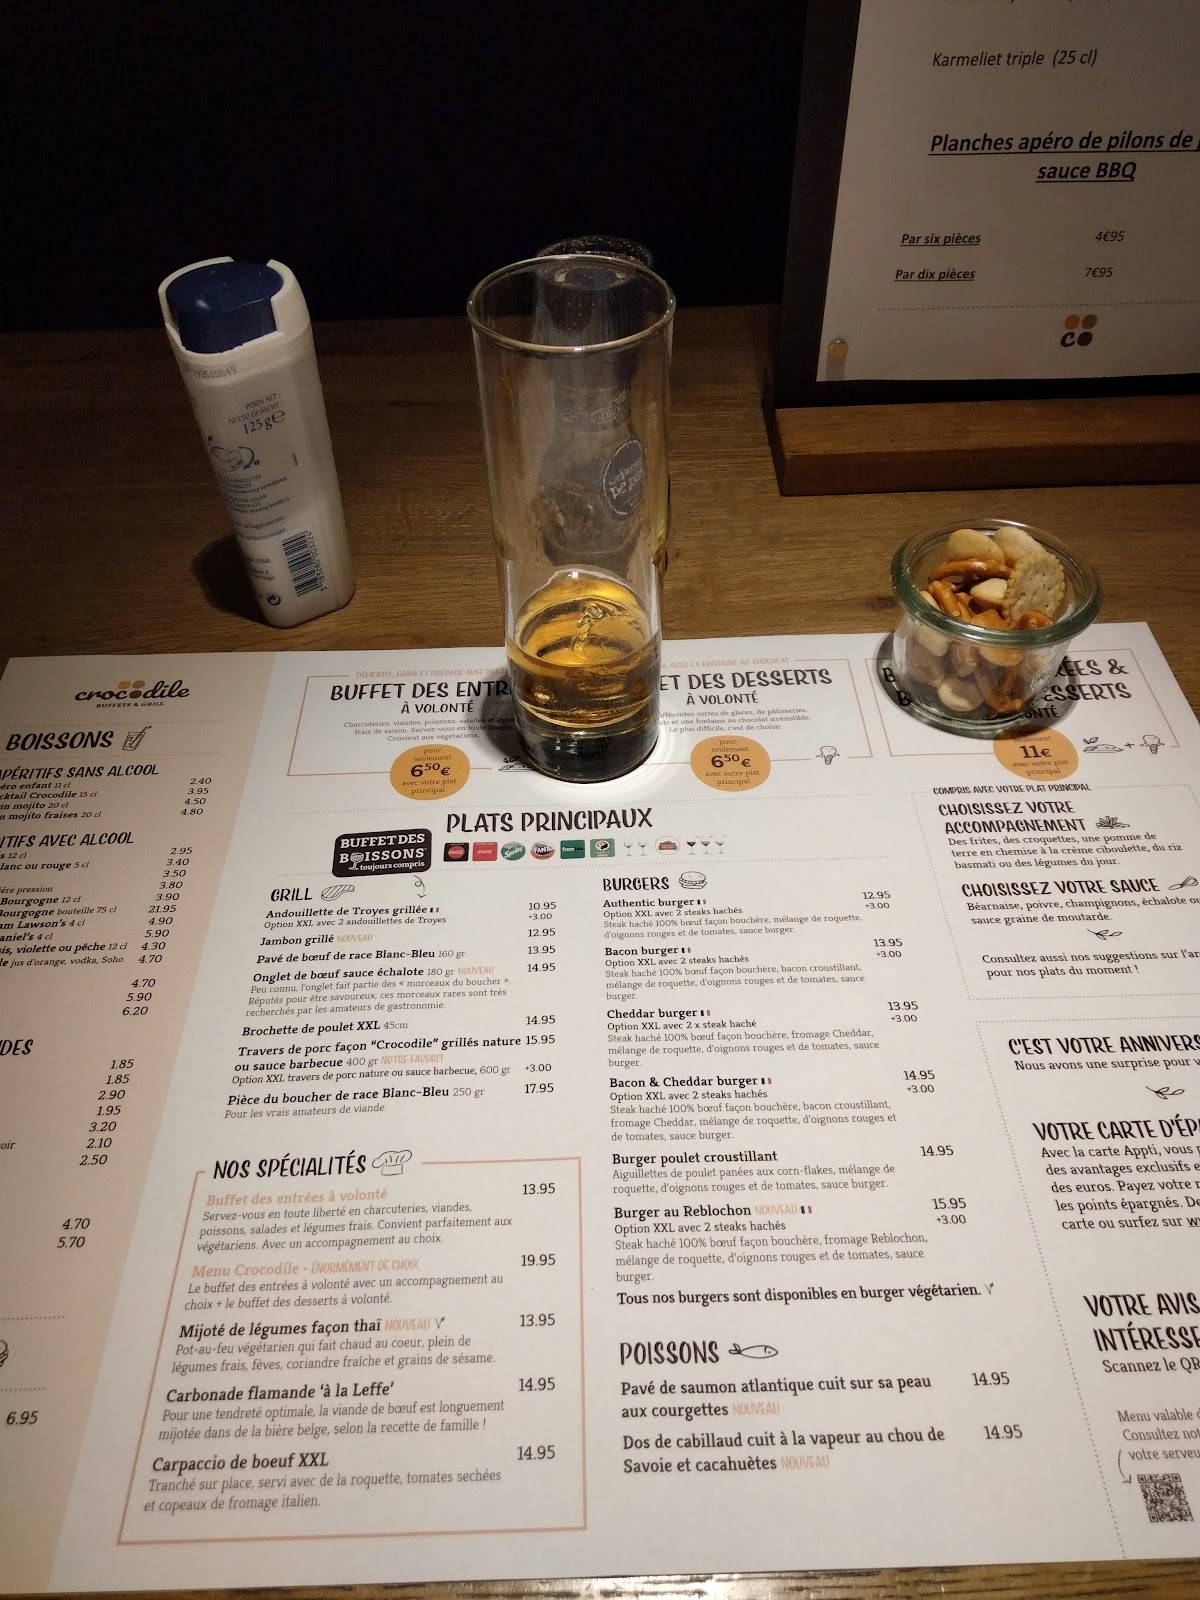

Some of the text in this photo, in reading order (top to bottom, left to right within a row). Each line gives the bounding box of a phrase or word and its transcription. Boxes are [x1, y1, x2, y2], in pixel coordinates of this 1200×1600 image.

[932, 49, 1098, 68] Karmeliet triple (25 cl)
[930, 130, 1193, 153] Planches apéro de pilons de
[1037, 162, 1137, 181] sauce BBQ
[901, 232, 982, 247] Par six pièces
[1095, 230, 1125, 242] 4€95
[895, 268, 976, 282] Par dix pièces
[1084, 267, 1113, 278] 7€95
[687, 668, 833, 690] DES DESSERTS
[330, 682, 449, 701] BUFFET DES
[456, 680, 512, 697] ENTR
[401, 699, 474, 714] À VOLONTÉ
[5, 730, 114, 751] BOISSONS
[1019, 745, 1052, 759] 11€
[0, 762, 159, 781] PÉRITIFS SANS ALCOOL
[190, 777, 212, 785] 2.40
[187, 787, 209, 795] 3.95
[933, 783, 1092, 795] COMPRIS AVEC VOTRE PLAT PRINCIPAL
[12, 801, 46, 812] mojito
[60, 801, 69, 809] cl
[183, 797, 207, 806] 4.50
[180, 808, 204, 816] 4.80
[938, 801, 1073, 816] CHOISISSEZ VOTRE
[446, 807, 653, 833] PLATS PRINCIPAUX
[945, 818, 1086, 835] ACCOMPAGNEMENT
[38, 831, 134, 847] AVEC ALCOOL
[340, 833, 425, 849] BUFFET DES
[947, 838, 968, 846] Des
[969, 837, 1001, 846] frites,
[1002, 835, 1021, 844] des
[1022, 835, 1080, 846] croquettes,
[1103, 834, 1142, 845] pomme
[1144, 832, 1157, 840] de
[359, 859, 425, 872] toujours compris
[603, 876, 670, 891] BURGERS
[961, 878, 1161, 898] CHOISISSEZ VOTRE SAUCE
[270, 887, 313, 902] GRILL
[148, 904, 177, 913] 21.95
[265, 905, 428, 919] Andouillette de Troyes grillée
[528, 901, 557, 911] 10.95
[144, 929, 170, 938] 5.90
[260, 933, 374, 947] Jambon grillé NOUVEAU
[528, 928, 556, 937] 12.95
[16, 944, 57, 954] violette
[73, 942, 106, 955] pêche
[108, 943, 118, 951] 12
[119, 942, 128, 950] cl
[140, 941, 166, 951] 4.30
[122, 1006, 149, 1016] 6.20
[888, 1001, 919, 1011] 13.95
[526, 1014, 556, 1025] 14.95
[606, 1008, 698, 1020] Cheddar burger
[241, 1020, 408, 1037] Brochette de poulet XXL 45cm
[1008, 1036, 1115, 1055] C'EST VOTRE
[97, 1089, 126, 1101] 2.90
[609, 1092, 643, 1103] Option
[645, 1091, 666, 1101] XXL
[692, 1090, 699, 1100] 2
[701, 1089, 732, 1099] steaks
[734, 1089, 768, 1099] hachés
[1032, 1119, 1158, 1141] VOTRE CARTE
[213, 1149, 367, 1179] NOS SPÉCIALITÉS
[522, 1182, 556, 1195] 13.95
[57, 1236, 86, 1249] 5.70
[1082, 1293, 1151, 1317] VOTRE
[620, 1340, 720, 1365] POISSONS
[1102, 1359, 1161, 1373] Scannez
[1163, 1357, 1177, 1371] le
[519, 1377, 556, 1392] 14.95
[621, 1375, 932, 1396] Pavé de saumon atlantique cuit sur sa peau
[972, 1371, 1010, 1386] 14.95
[166, 1386, 244, 1403] Carbonade
[247, 1384, 316, 1400] flamande
[335, 1382, 348, 1397] la
[6, 1410, 39, 1425] 6.95
[518, 1444, 556, 1461] 14.95
[152, 1452, 329, 1477] Carpaccio de boeuf XXL
